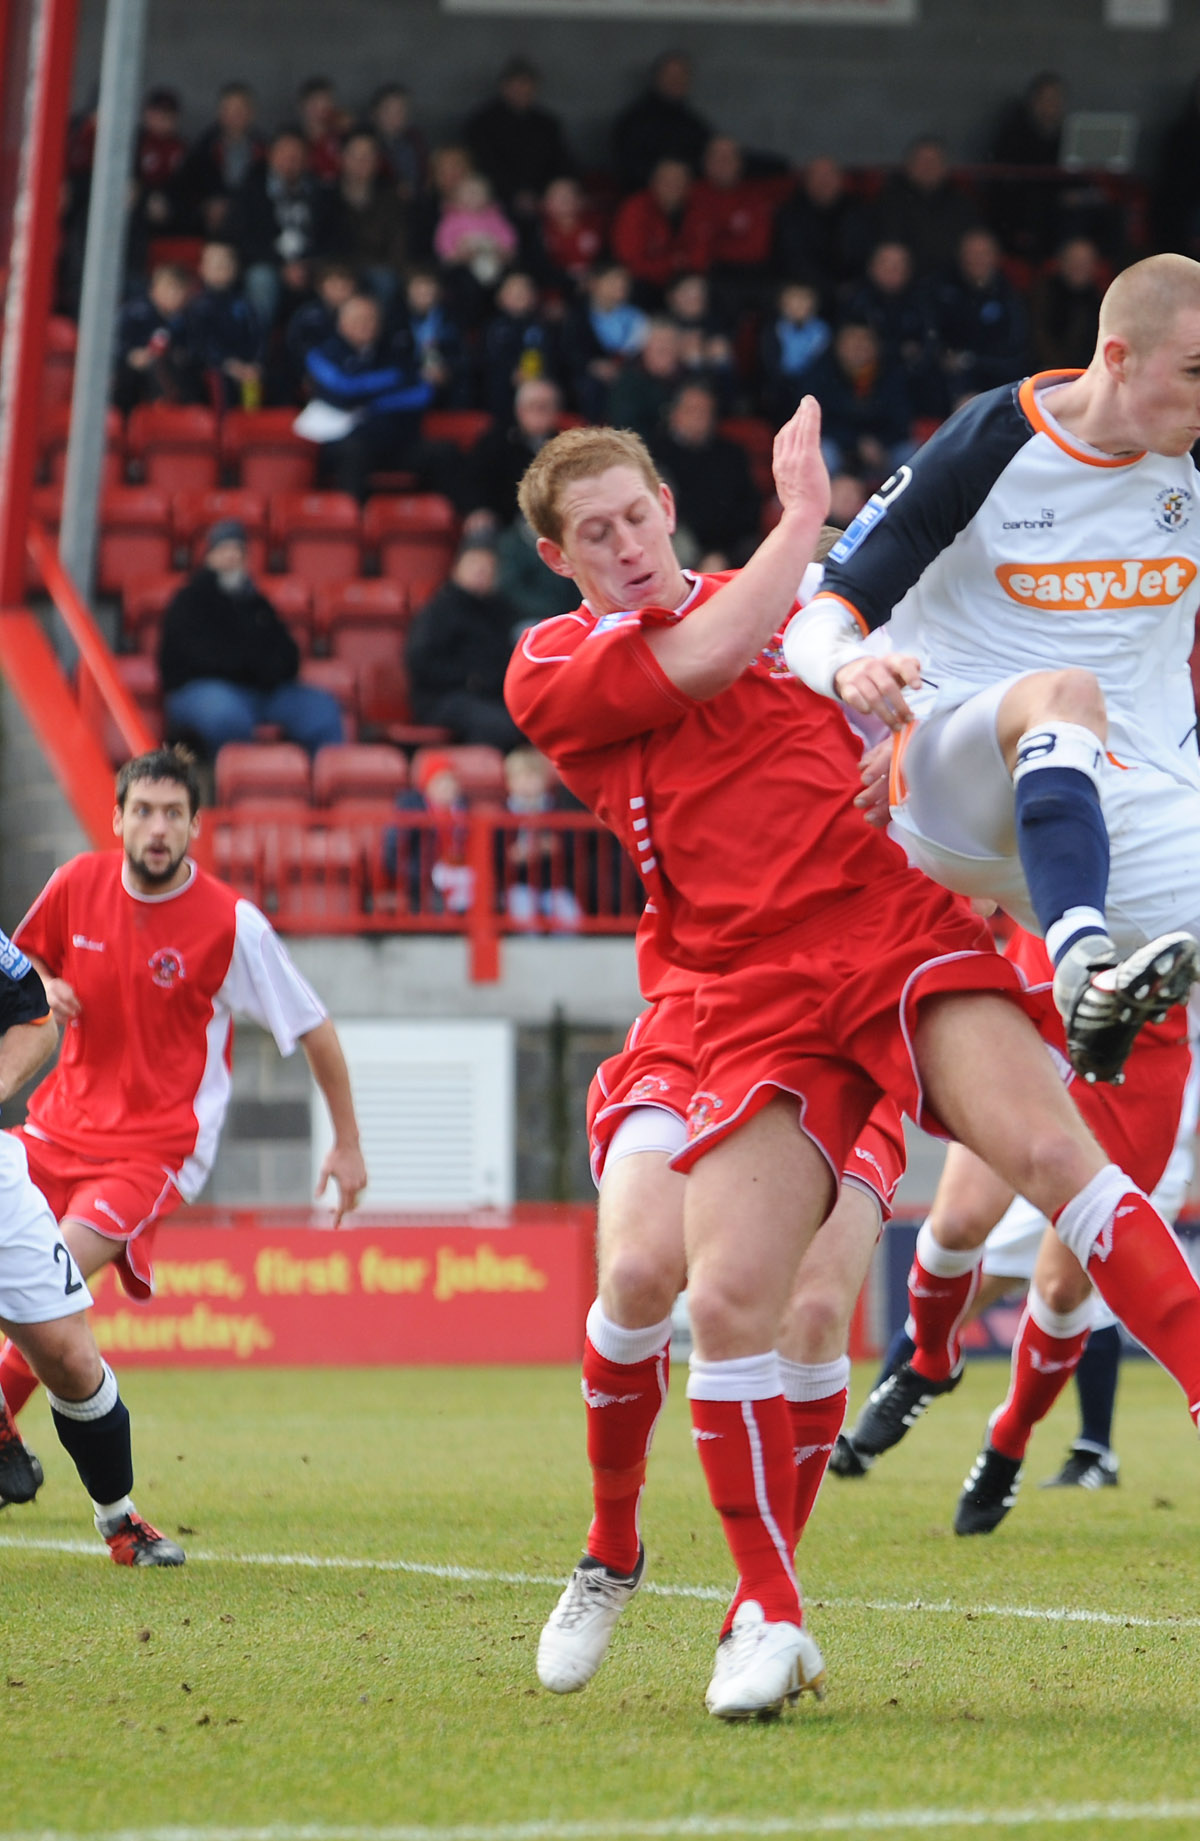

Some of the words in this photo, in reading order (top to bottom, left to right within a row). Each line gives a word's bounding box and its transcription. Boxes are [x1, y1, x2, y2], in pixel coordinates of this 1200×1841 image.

[1008, 561, 1187, 609] easyJet
[53, 1242, 83, 1295] 2
[256, 1246, 350, 1296] first
[360, 1244, 429, 1295] for
[433, 1243, 549, 1302] jobs.
[91, 1303, 275, 1359] aturday.
